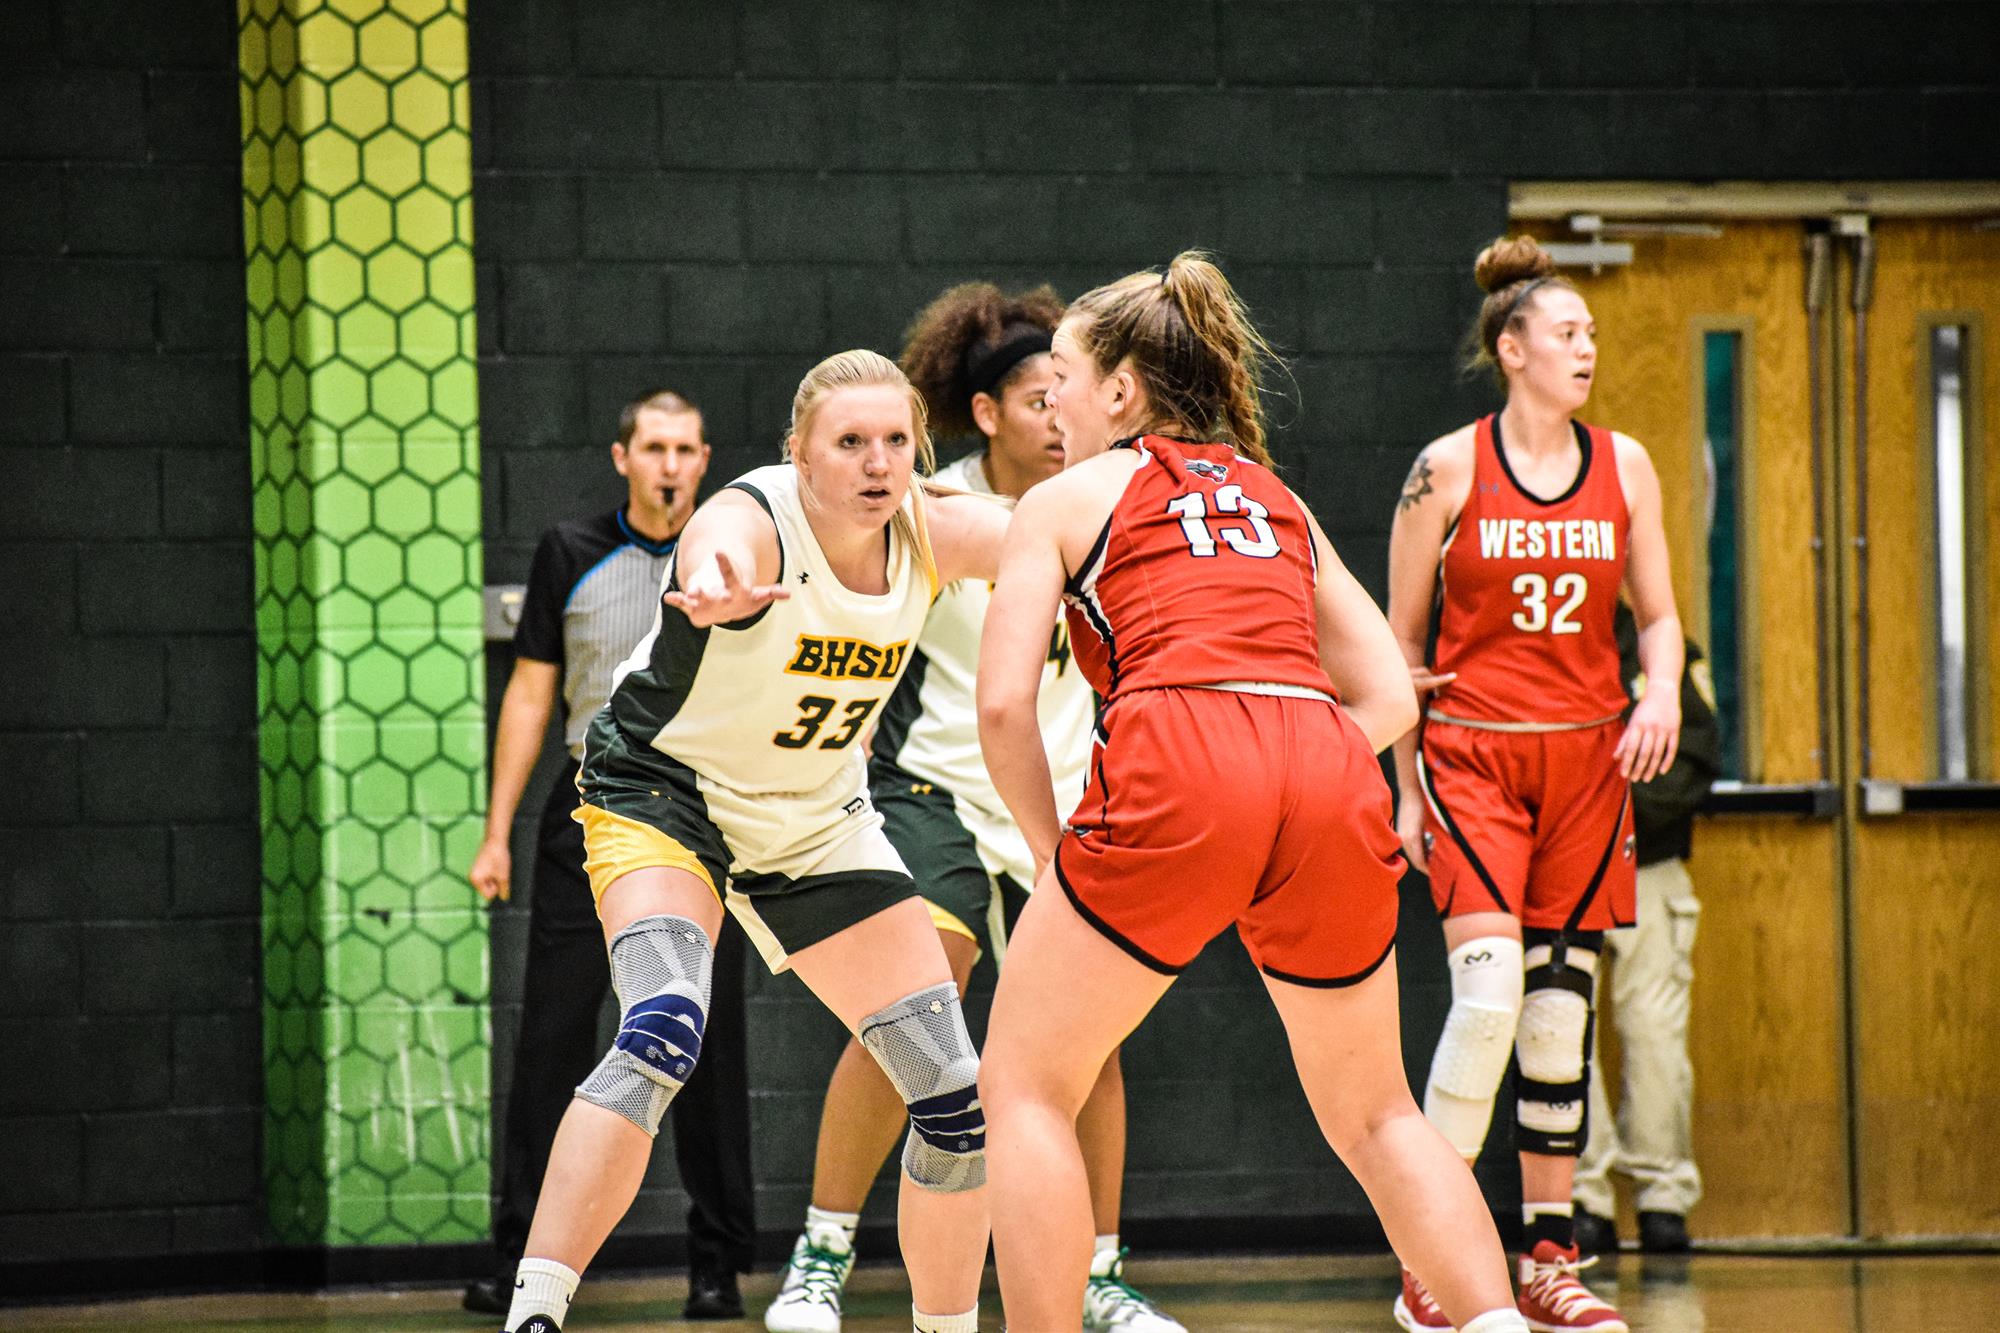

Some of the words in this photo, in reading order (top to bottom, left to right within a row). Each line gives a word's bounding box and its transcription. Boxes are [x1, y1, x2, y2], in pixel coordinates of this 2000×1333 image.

[1167, 484, 1281, 558] 13
[1479, 518, 1616, 560] WESTERN
[1512, 573, 1588, 634] 32
[787, 634, 910, 681] BHSU
[773, 695, 880, 749] 33
